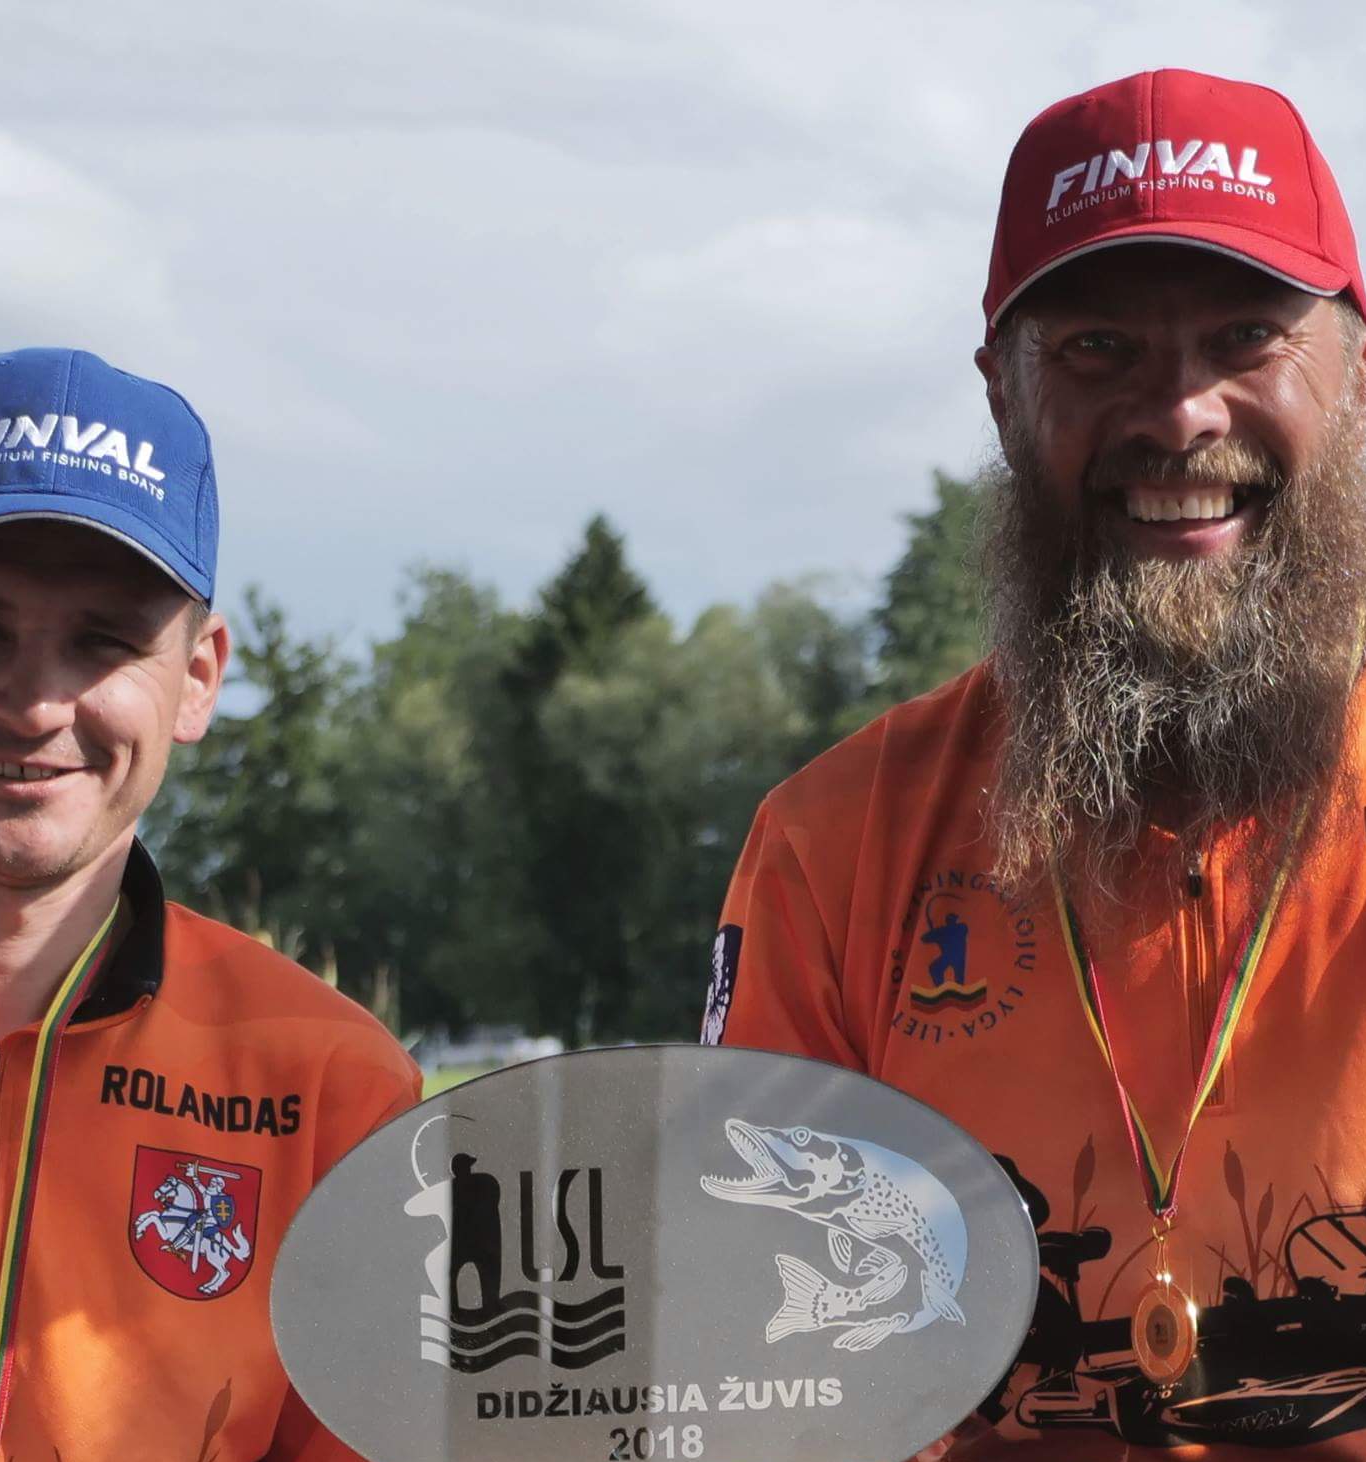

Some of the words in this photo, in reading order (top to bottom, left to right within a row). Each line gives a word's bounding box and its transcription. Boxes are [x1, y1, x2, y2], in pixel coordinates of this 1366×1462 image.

[1045, 138, 1273, 210] FINVAL
[1045, 184, 1132, 227] ALUMINIUM
[1139, 174, 1215, 194] FISHING
[1222, 181, 1277, 206] BOATS
[42, 450, 112, 476] FISHING
[118, 469, 166, 501] BOATS
[100, 1064, 302, 1138] ROLANDAS
[476, 1382, 709, 1420] DIDŽIAUSIA
[718, 1377, 844, 1412] ŽUVIS
[608, 1424, 704, 1461] 2018
